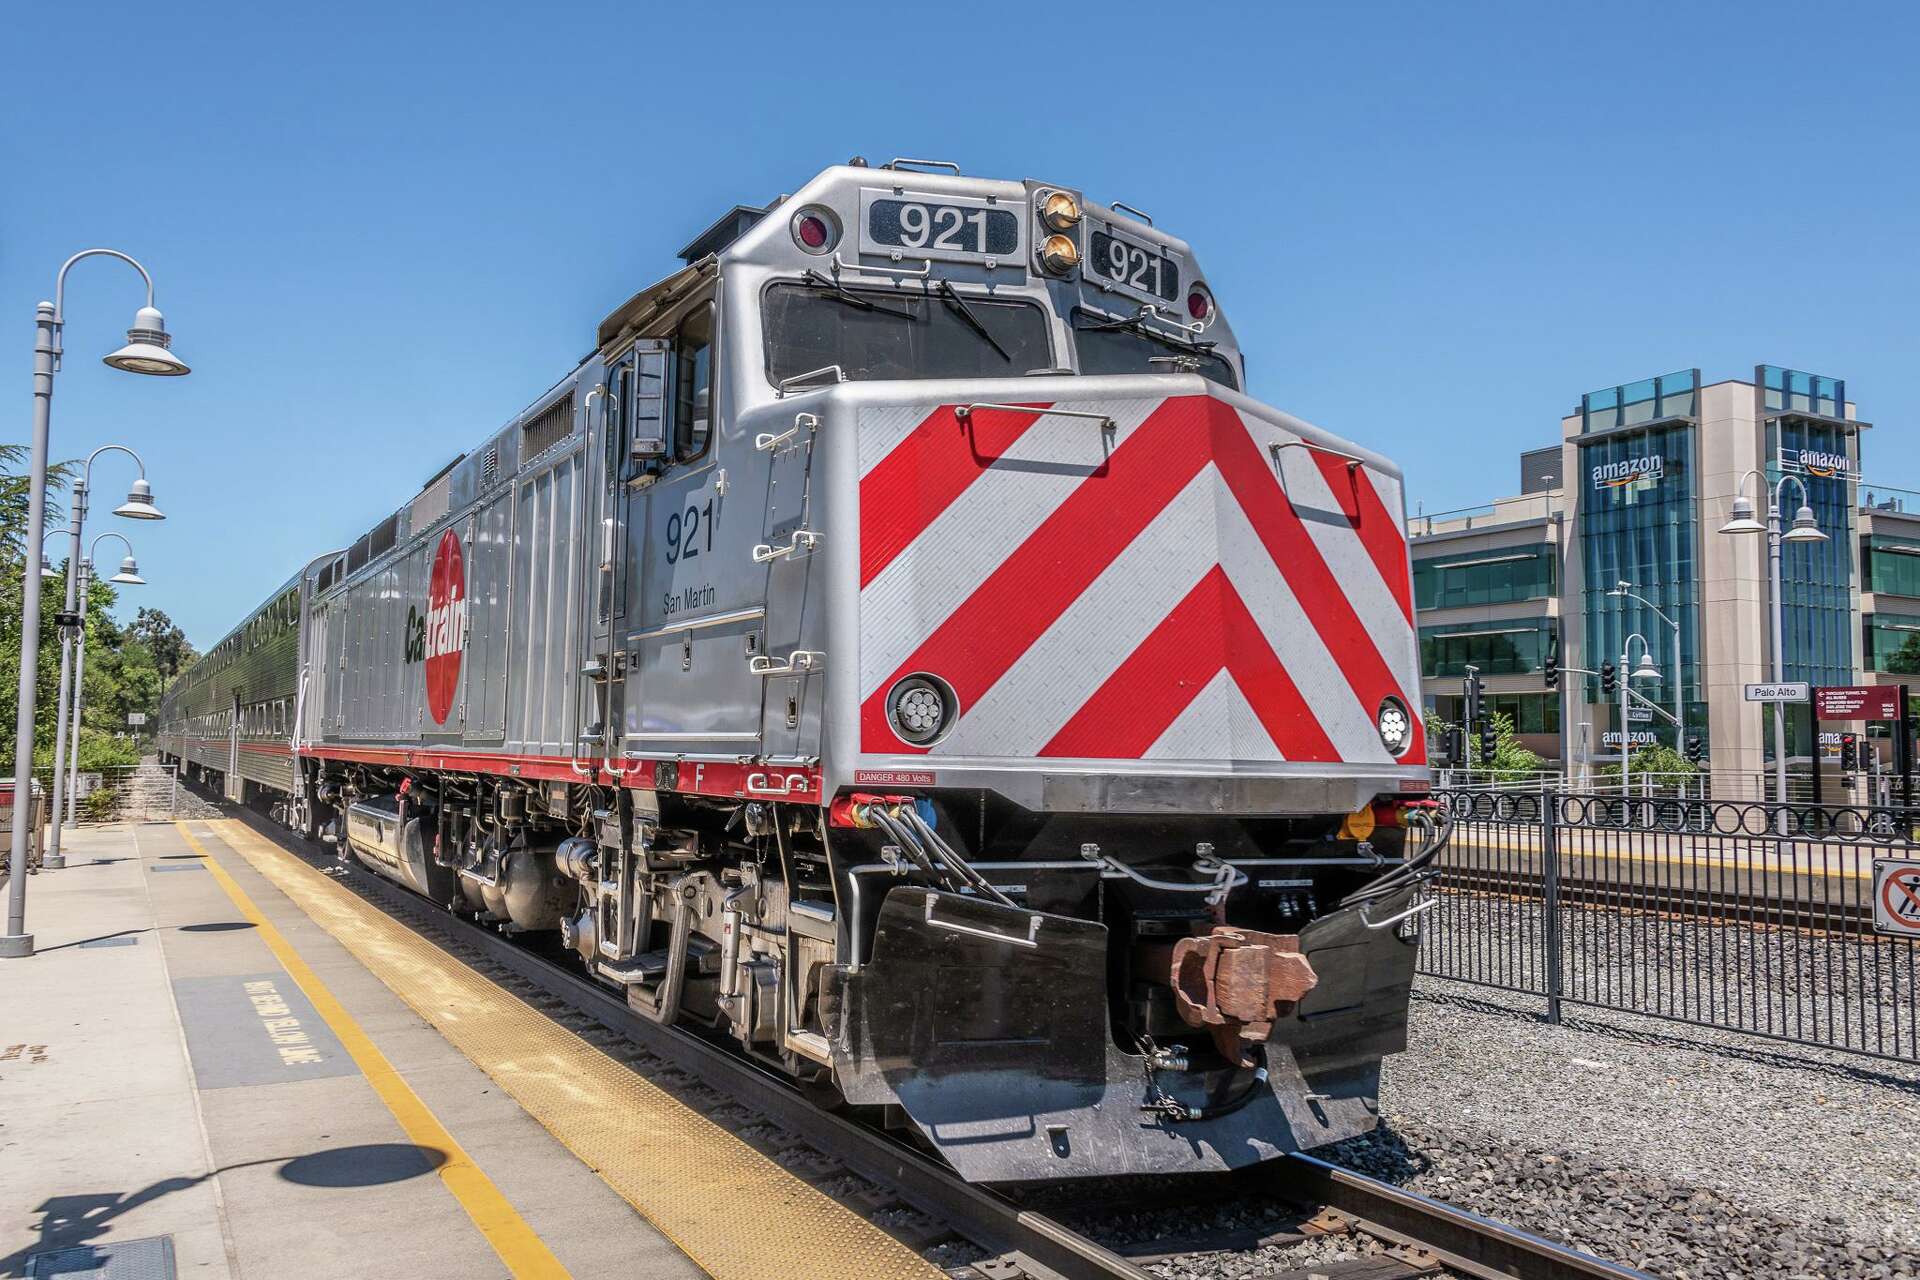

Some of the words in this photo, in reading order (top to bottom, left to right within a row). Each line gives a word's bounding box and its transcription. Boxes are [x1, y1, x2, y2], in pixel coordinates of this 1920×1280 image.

[900, 203, 987, 253] 921
[1109, 240, 1161, 296] 921
[1592, 455, 1660, 481] amazon
[1800, 449, 1850, 470] amazon
[666, 498, 713, 565] 921
[663, 592, 681, 615] San
[684, 583, 715, 610] Martin
[1754, 688, 1775, 697] Palo
[1777, 688, 1797, 697] Alto
[1602, 731, 1654, 743] amzon
[695, 763, 705, 792] F
[859, 773, 894, 781] DANGER
